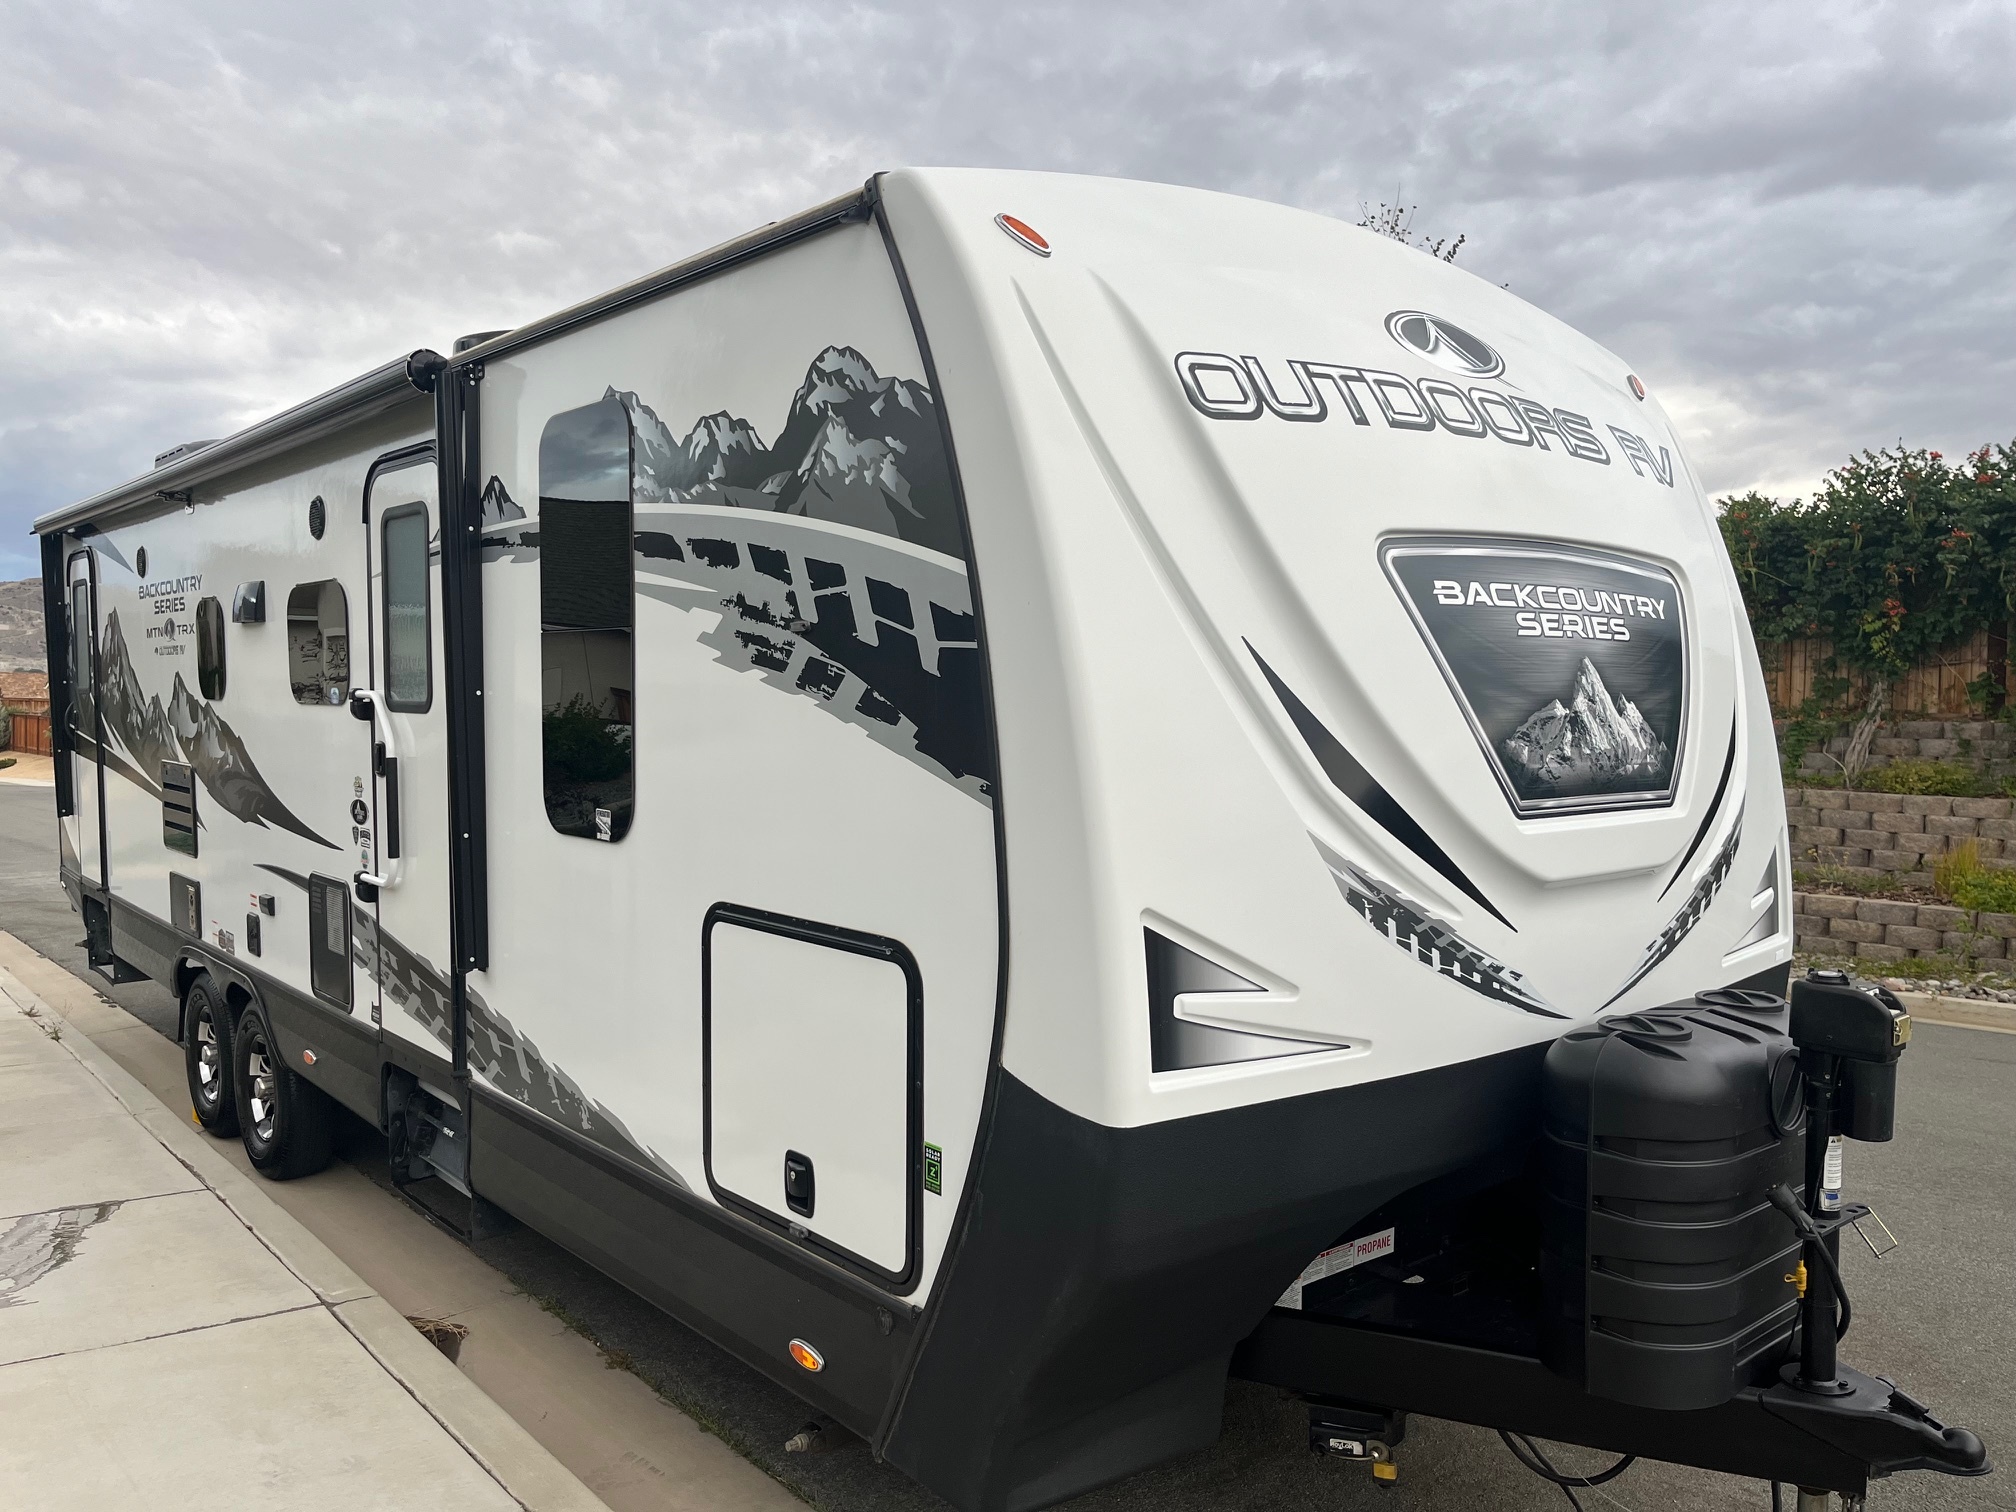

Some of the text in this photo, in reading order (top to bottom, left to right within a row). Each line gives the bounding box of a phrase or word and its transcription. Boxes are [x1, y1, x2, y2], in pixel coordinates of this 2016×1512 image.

[1174, 351, 1674, 489] OUTDOORS RV
[138, 574, 203, 600] BACKCOUNTRY
[1432, 579, 1666, 620] BACKCOUNTRY
[154, 597, 186, 615] SERIES
[146, 623, 196, 639] MTN TRX
[1515, 612, 1631, 642] SERIES
[1356, 1234, 1391, 1258] PROPANE
